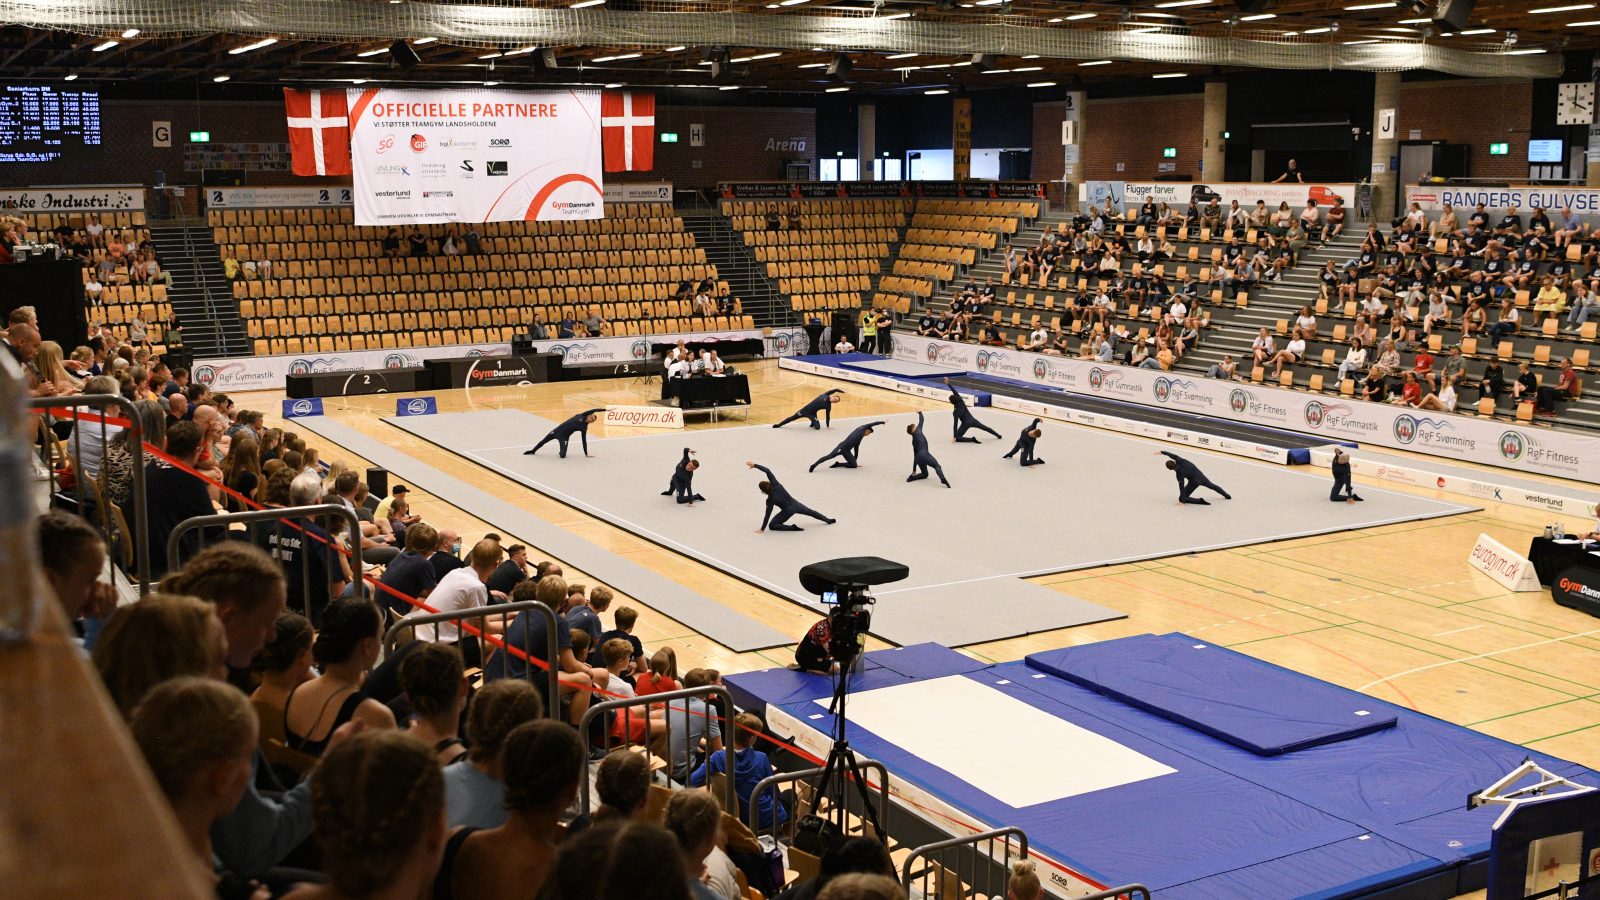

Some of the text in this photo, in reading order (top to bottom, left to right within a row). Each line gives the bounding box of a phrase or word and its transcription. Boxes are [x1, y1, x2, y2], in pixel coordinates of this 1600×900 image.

[372, 102, 558, 118] OFFICIELLE PARTNERE
[1382, 115, 1391, 132] J
[155, 127, 169, 142] G
[691, 128, 701, 141] H
[490, 138, 510, 146] SORØ
[764, 137, 807, 152] Arena
[1126, 184, 1175, 195] Flügger farver
[41, 193, 109, 209] Industri
[552, 201, 596, 210] GymDanmark
[1442, 192, 1522, 209] RANDERS
[569, 351, 614, 361] RgF Svømning
[496, 360, 502, 369] 1
[623, 364, 629, 373] 3
[219, 371, 274, 383] RgF Gymnastik
[363, 374, 371, 385] 2
[472, 367, 528, 381] GymDanmark
[1115, 380, 1143, 392] Gymnastik
[1172, 389, 1213, 405] RgF Svømning
[1249, 402, 1287, 416] RgF Fitness
[607, 410, 676, 425] eurogym.dk
[1327, 415, 1340, 426] RgF
[1341, 417, 1378, 431] Gymnastik
[1419, 429, 1476, 450] RgF Svømning
[1527, 447, 1579, 465] RgF Fitness
[1525, 494, 1563, 507] vesterlund
[1472, 543, 1520, 581] eurogym.dk
